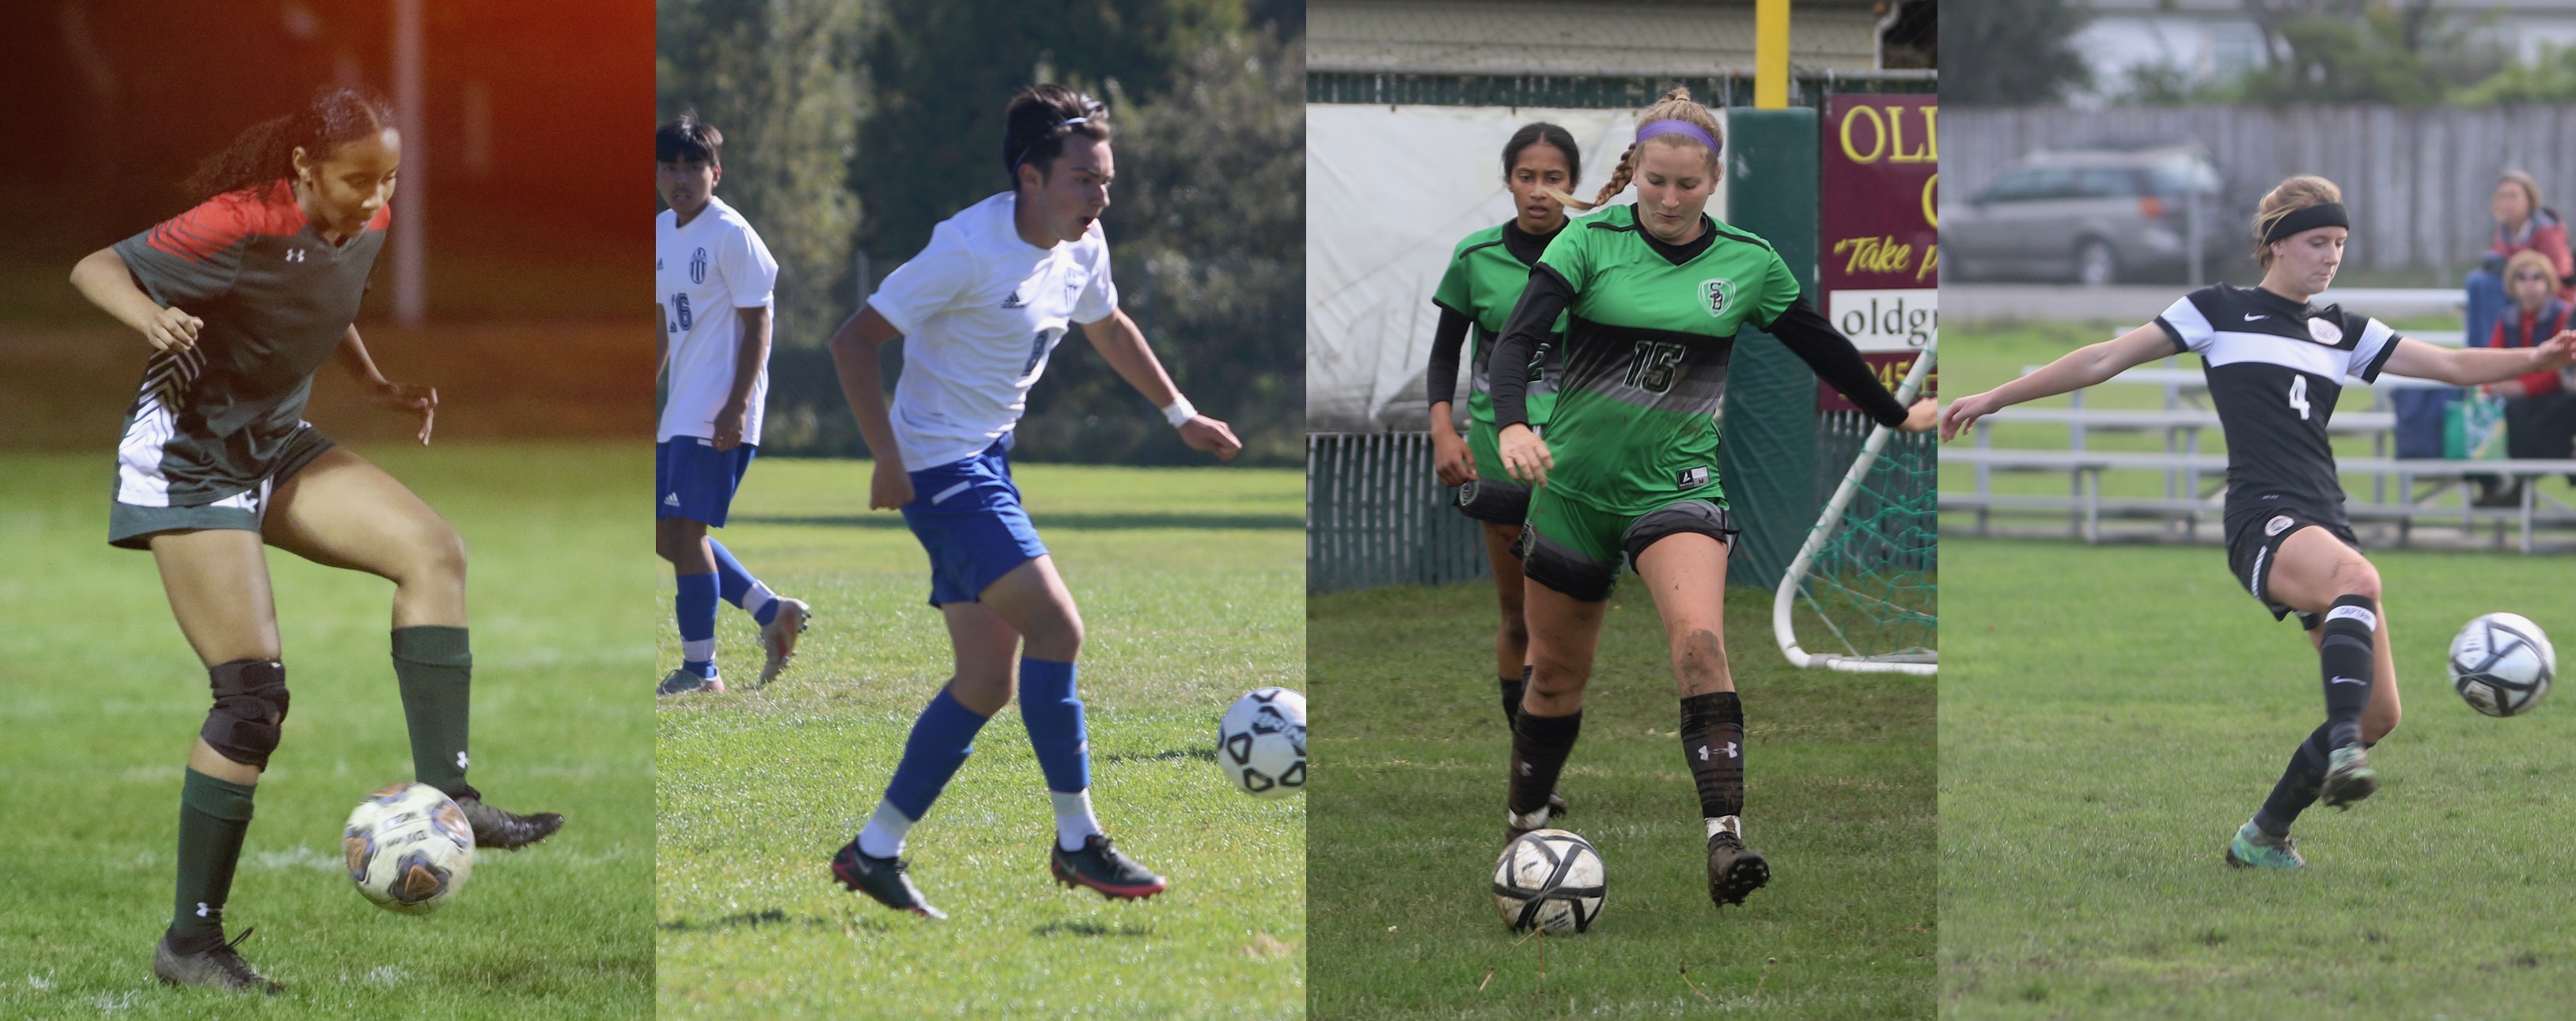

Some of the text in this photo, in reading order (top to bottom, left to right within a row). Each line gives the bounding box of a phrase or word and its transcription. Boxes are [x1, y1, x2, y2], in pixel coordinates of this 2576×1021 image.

[1842, 297, 1938, 347] oldg
[1622, 340, 1686, 396] 15
[2289, 374, 2310, 420] 4
